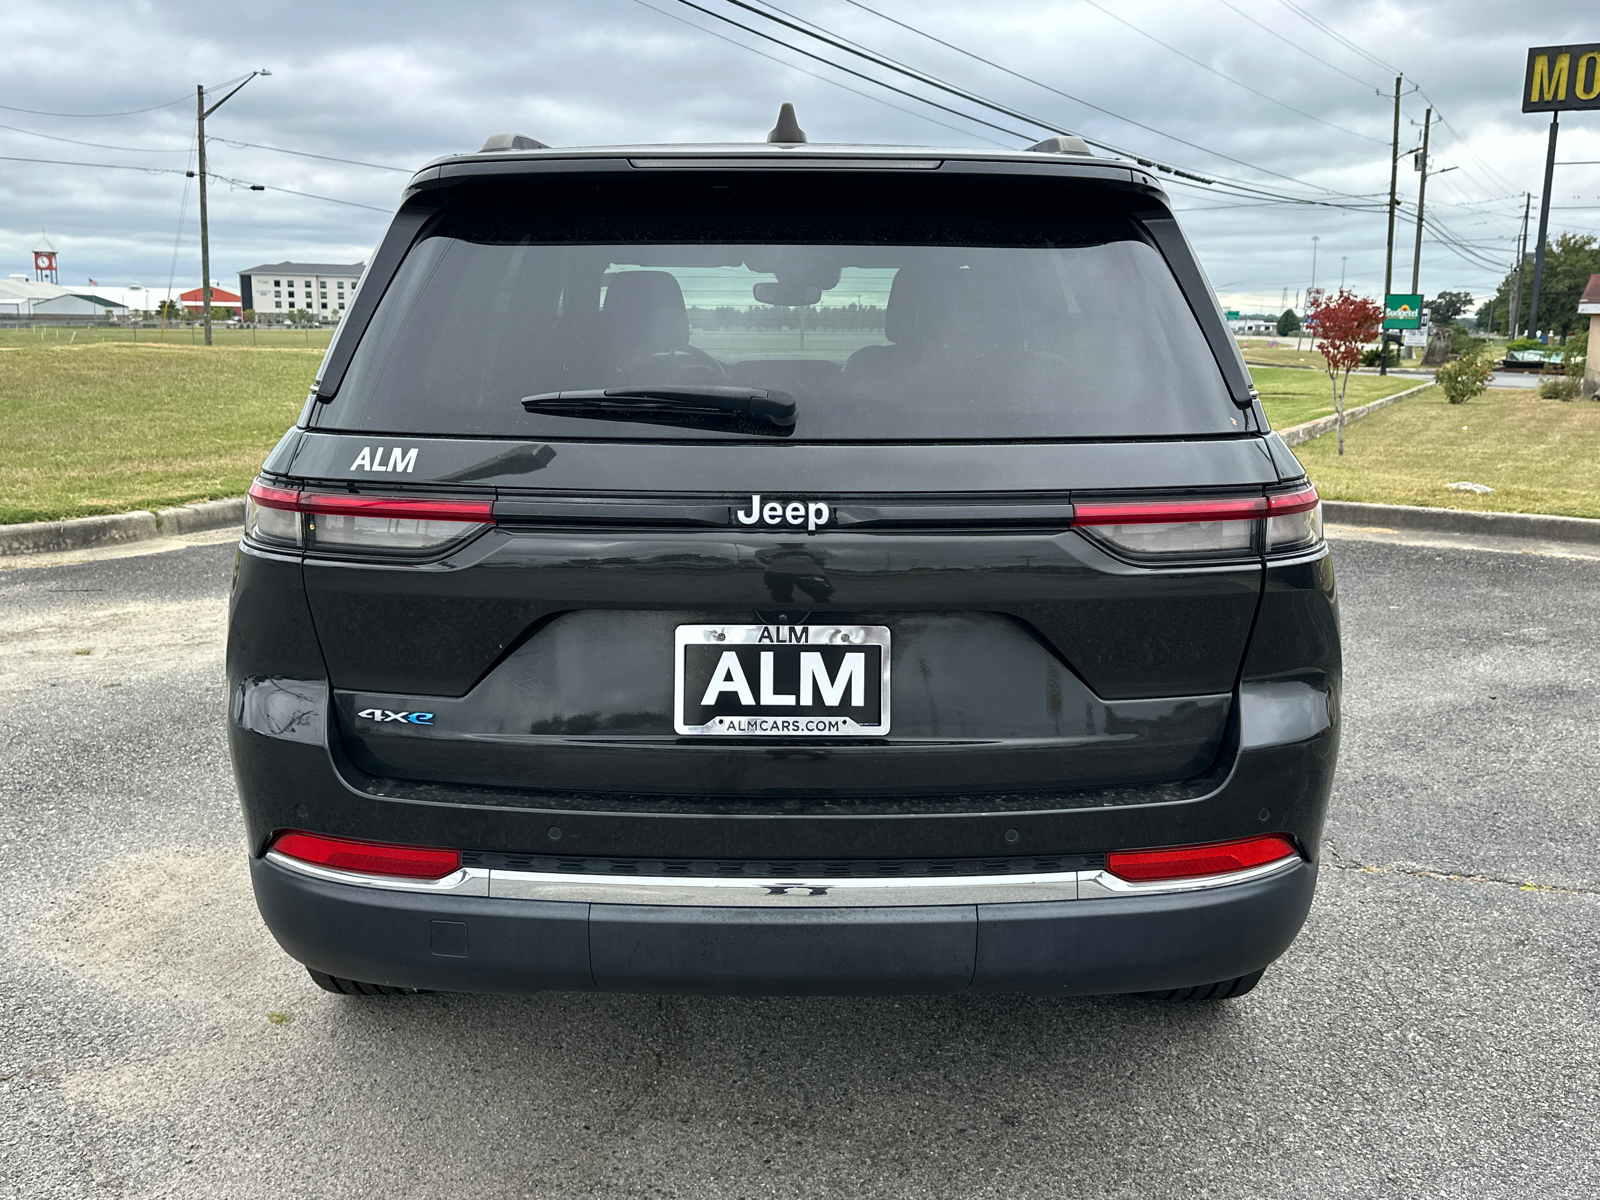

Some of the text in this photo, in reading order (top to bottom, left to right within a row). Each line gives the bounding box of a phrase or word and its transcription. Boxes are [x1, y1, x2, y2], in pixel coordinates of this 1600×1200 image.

[1530, 50, 1600, 102] MO
[1385, 307, 1419, 319] Budgetel
[349, 446, 419, 473] ALM
[736, 494, 830, 531] Jeep
[757, 626, 809, 644] ALM
[700, 650, 865, 707] ALM
[726, 720, 840, 732] ALMCARS.COM
